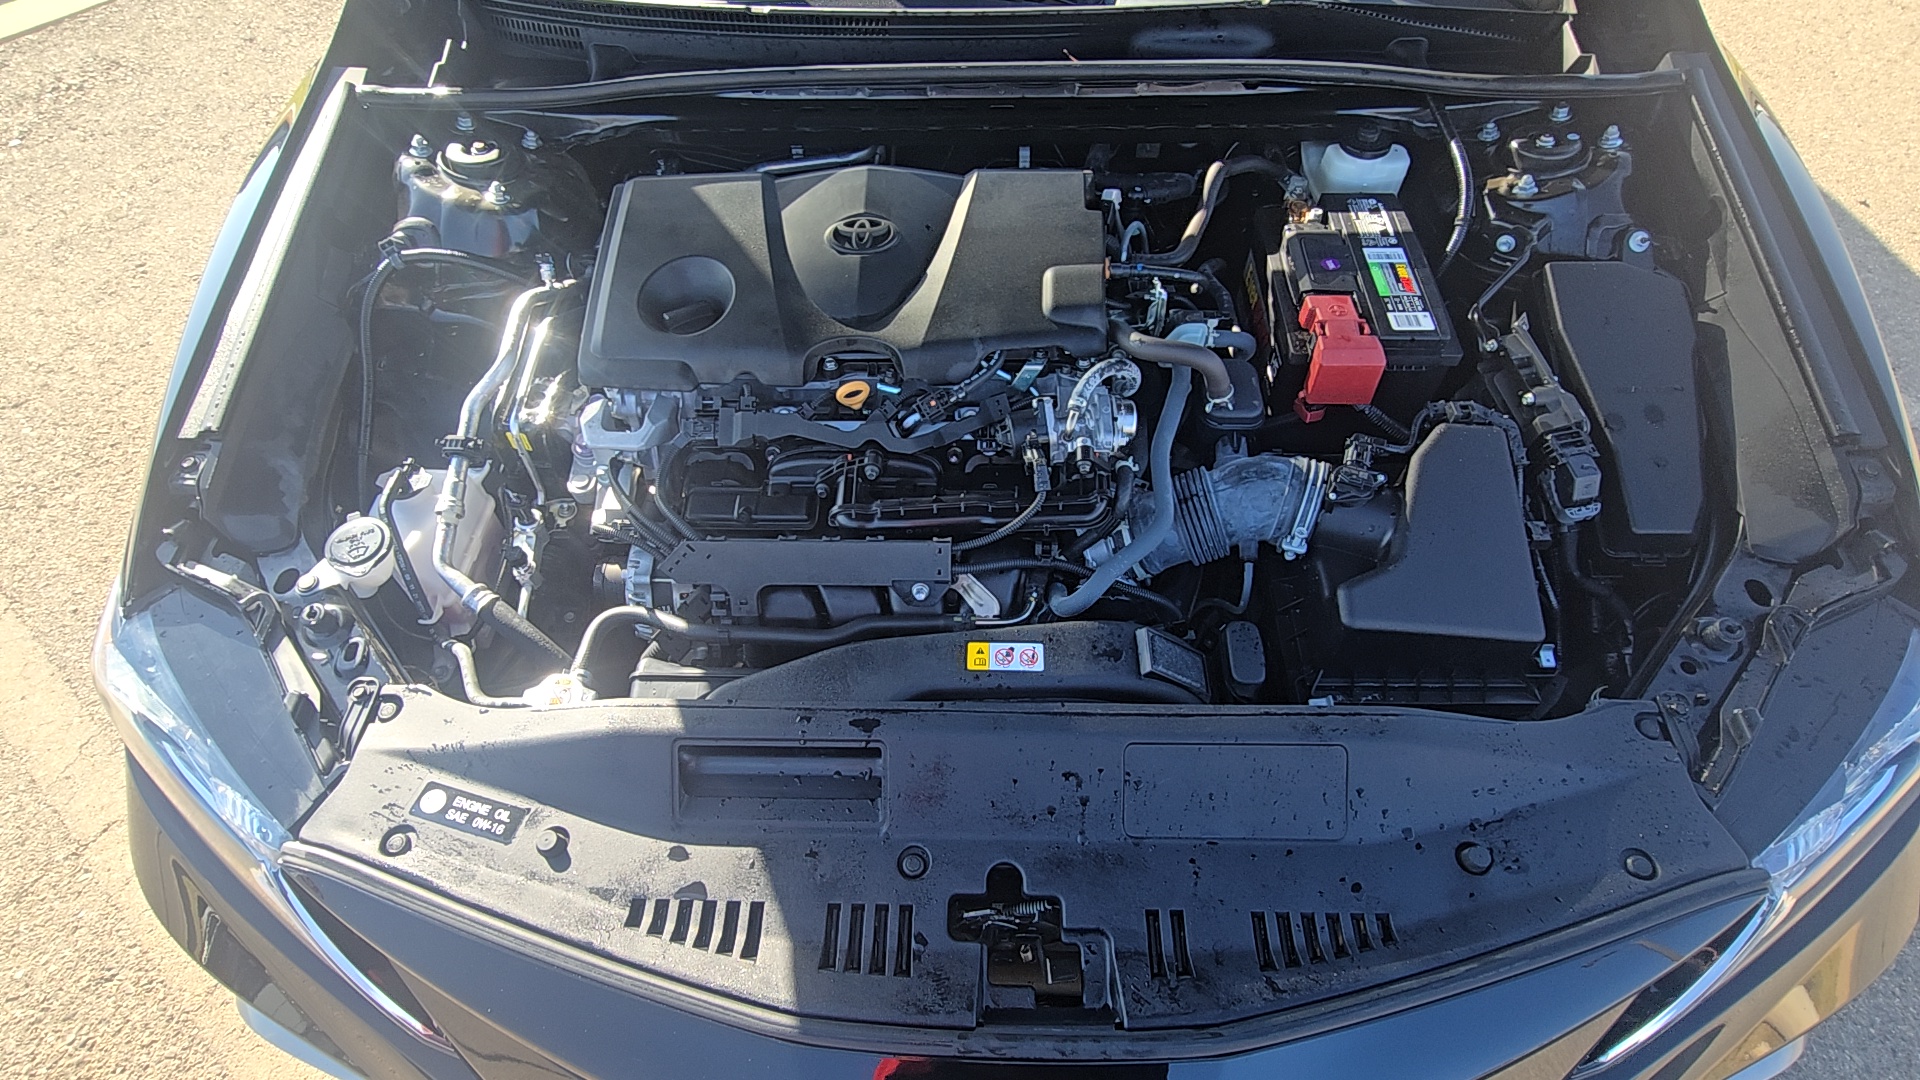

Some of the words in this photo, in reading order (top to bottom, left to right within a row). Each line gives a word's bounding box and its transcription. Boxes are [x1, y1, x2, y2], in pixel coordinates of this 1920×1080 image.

[445, 808, 470, 824] SAE
[471, 817, 506, 835] 0W-16
[452, 796, 492, 816] ENGINE
[494, 808, 511, 823] OIL
